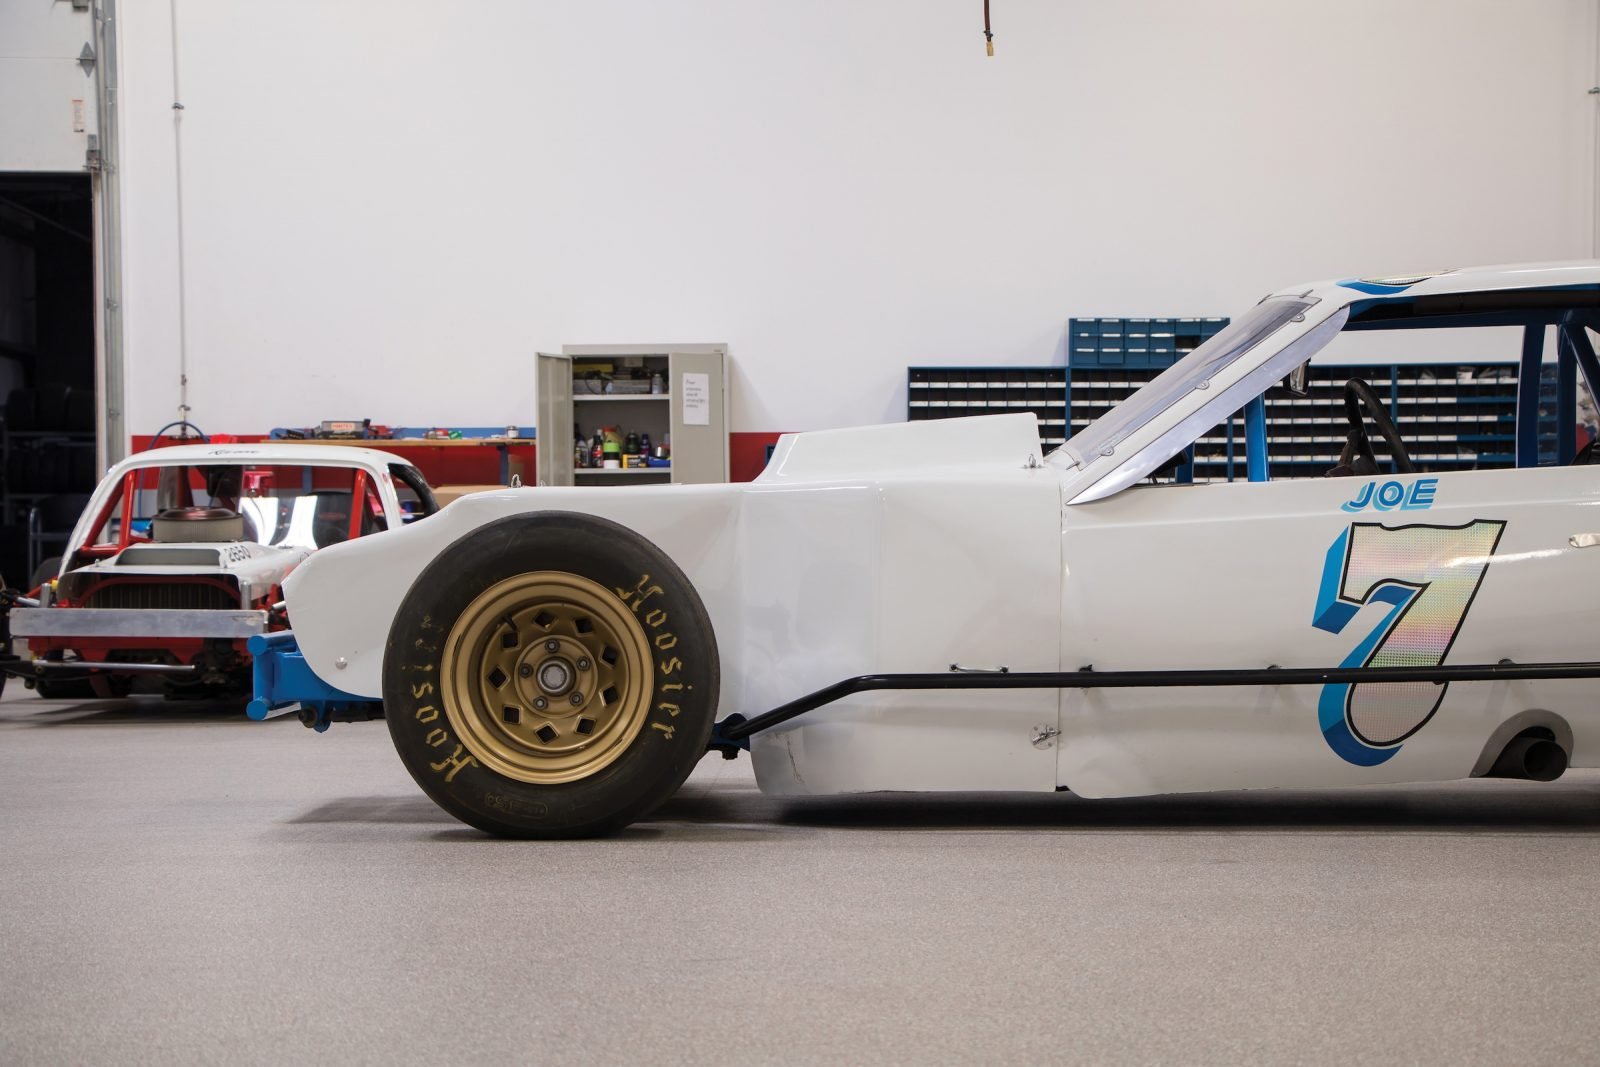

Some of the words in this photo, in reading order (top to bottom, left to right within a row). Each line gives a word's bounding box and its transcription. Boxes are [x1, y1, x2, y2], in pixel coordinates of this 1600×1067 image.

[1340, 478, 1439, 513] JOE
[616, 574, 693, 740] Hoosier
[1312, 519, 1508, 767] 7
